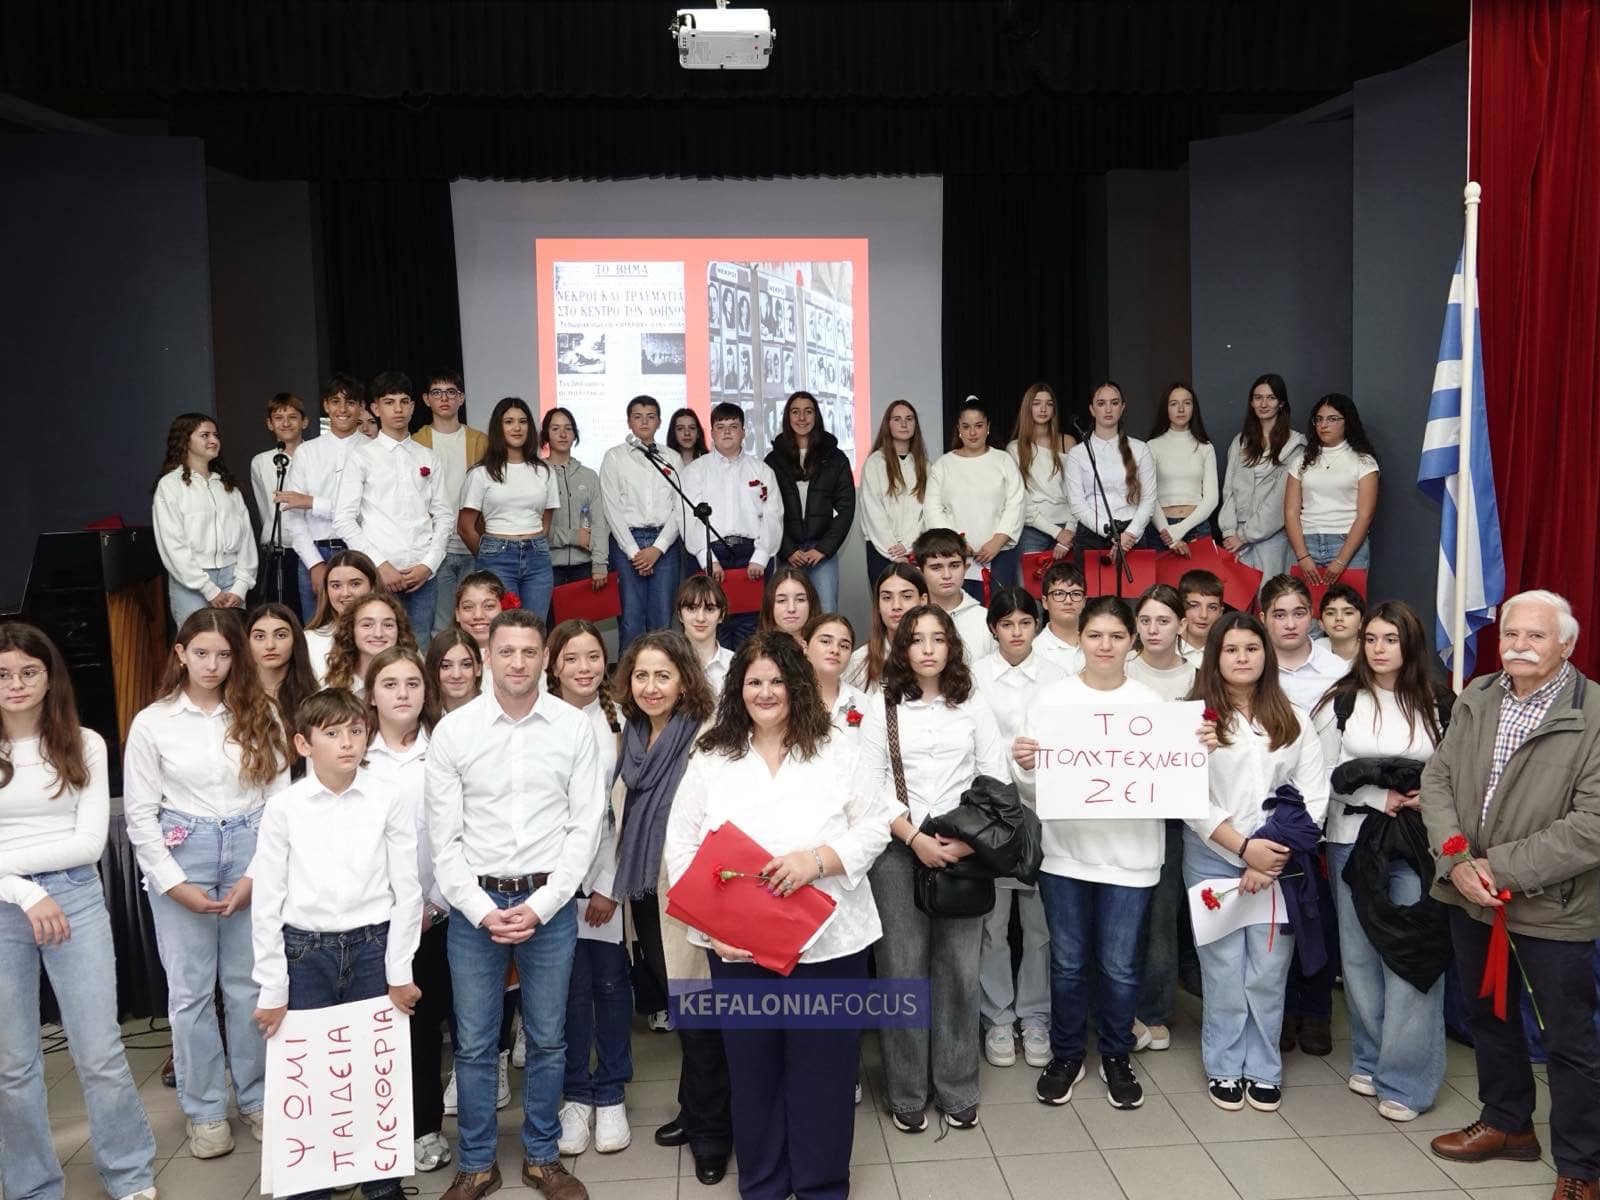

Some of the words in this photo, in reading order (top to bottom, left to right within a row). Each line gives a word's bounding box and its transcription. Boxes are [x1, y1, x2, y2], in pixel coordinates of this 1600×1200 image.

[595, 264, 610, 275] ΤΟ
[616, 264, 649, 275] ΒΗΜΑ
[557, 290, 597, 302] ΝΕΚΡΟΙ
[601, 290, 620, 302] ΚΑΙ
[557, 305, 577, 317] ΣΤΟ
[580, 305, 620, 317] ΚΕΝΤΡΟ
[625, 305, 643, 317] ΤΩΝ
[1093, 713, 1153, 736] ΤΟ
[1036, 748, 1206, 770] ΠΟΛΥΤΕΧΝΕΙΟ
[1084, 778, 1155, 804] ΖΕΙ
[327, 1025, 355, 1172] ΠΑΙΔΕΙΑ
[373, 1007, 398, 1172] ΕΛΕΥΘΕΡΙΑ
[283, 1039, 315, 1168] ΨΩΜΙ
